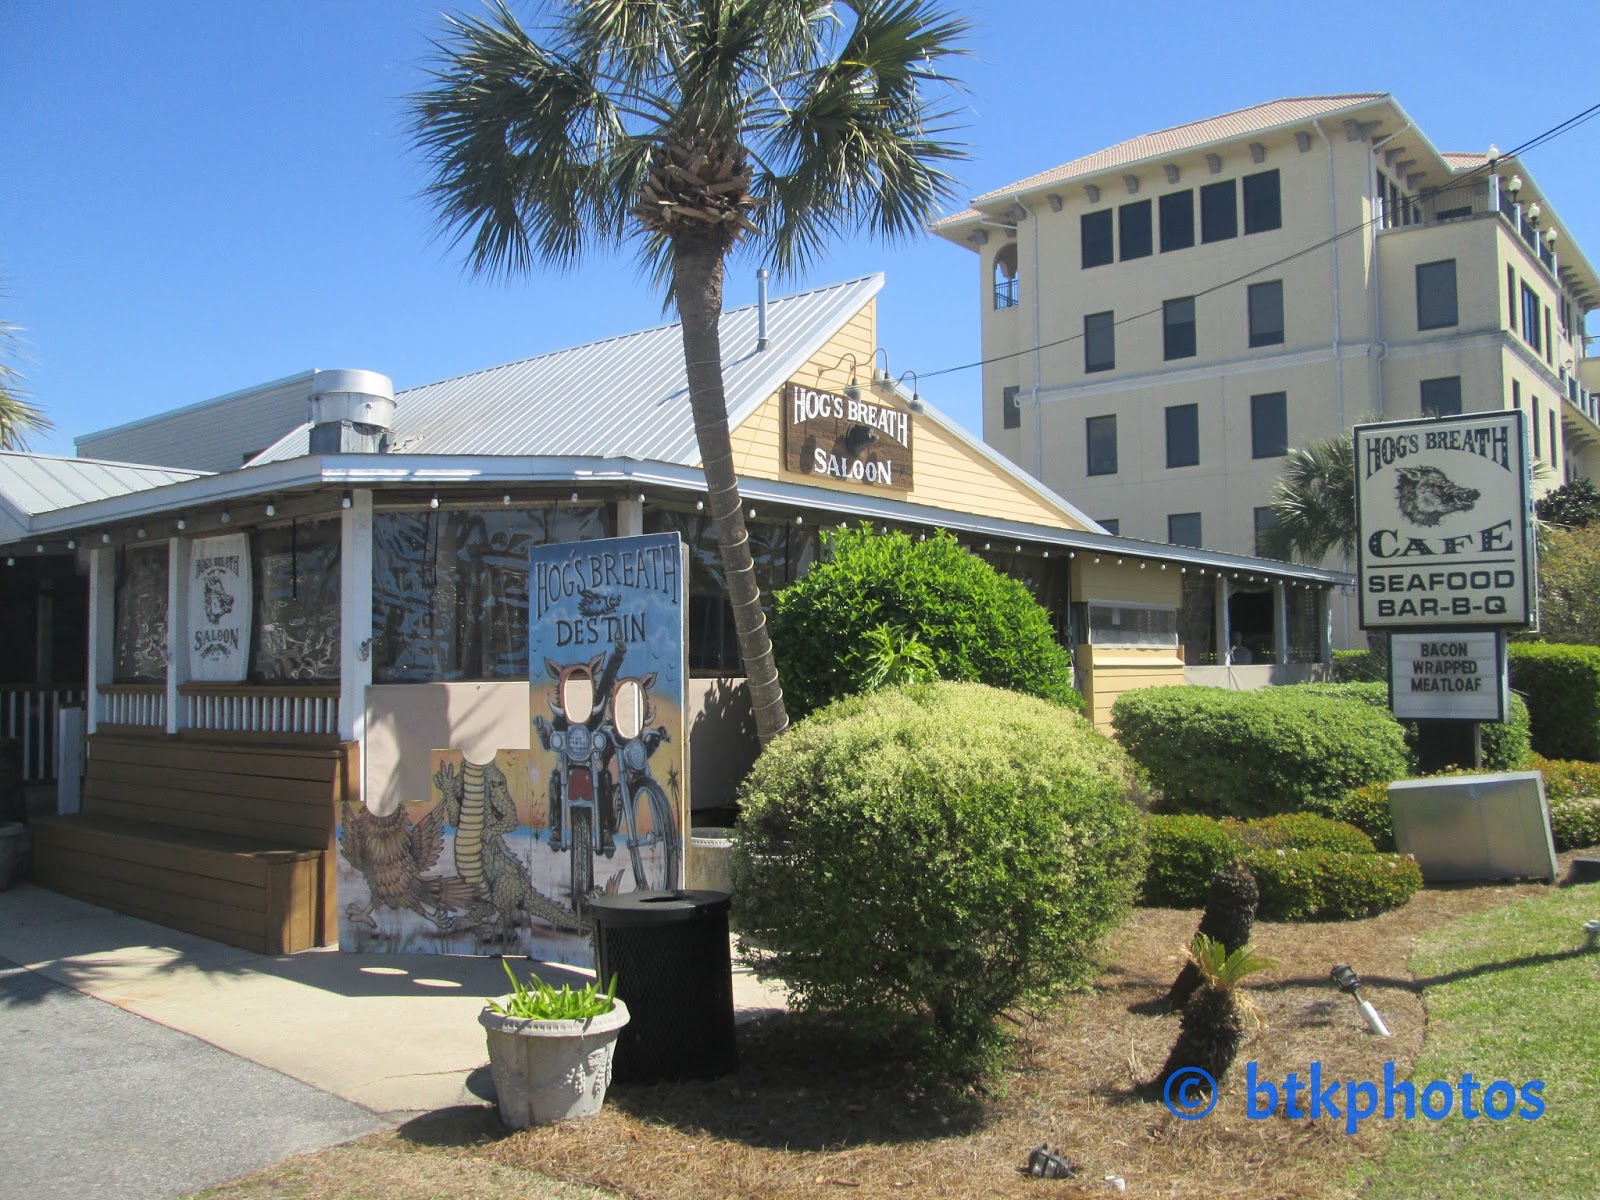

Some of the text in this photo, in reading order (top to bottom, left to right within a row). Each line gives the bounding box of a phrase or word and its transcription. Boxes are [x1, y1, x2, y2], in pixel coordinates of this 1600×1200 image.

[793, 385, 909, 449] HOG'S BREATH
[1365, 426, 1512, 480] HOG'S BREATH
[814, 447, 892, 485] SALOON
[1368, 519, 1513, 558] CAFE
[213, 555, 240, 578] BREATH
[536, 544, 678, 620] HOG'S BREATH
[1368, 569, 1515, 593] SEAFOOD
[1378, 595, 1507, 617] BAR-B-Q
[194, 628, 239, 650] SALOON
[556, 612, 647, 647] DESTIN
[1420, 643, 1468, 658] BACON
[1413, 661, 1478, 675] WRAPPED
[1410, 677, 1482, 692] MEATLOAF
